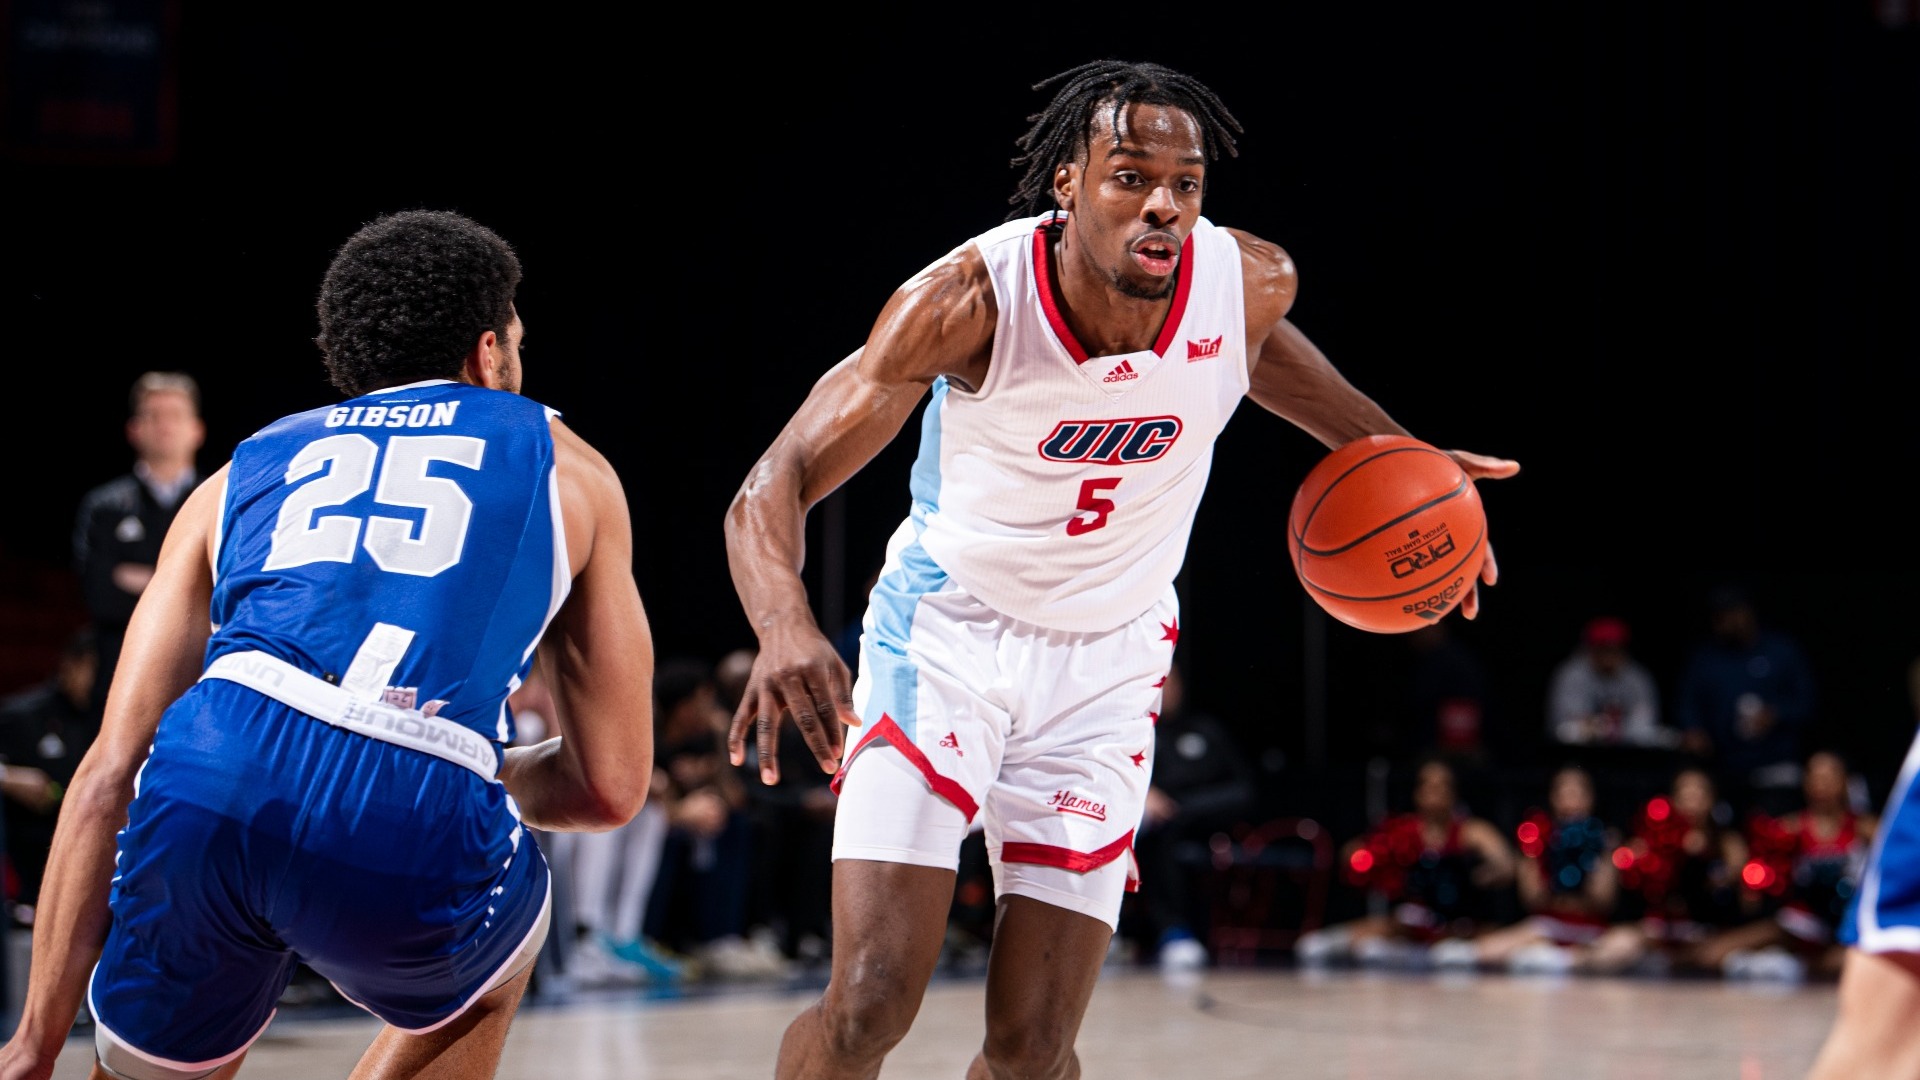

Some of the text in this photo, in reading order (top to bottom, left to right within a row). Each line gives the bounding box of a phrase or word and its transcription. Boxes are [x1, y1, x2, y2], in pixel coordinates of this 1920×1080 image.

[1103, 372, 1139, 383] adidas
[324, 400, 461, 429] GIBSON
[1041, 416, 1181, 463] UIC
[261, 433, 486, 578] 25
[1066, 477, 1123, 536] 5
[1403, 538, 1421, 551] GAME
[1422, 522, 1447, 540] OFFICIAL
[1384, 547, 1403, 558] BALL
[1391, 532, 1456, 579] PRO
[1402, 576, 1464, 614] adidas
[344, 701, 493, 767] ARMOUR
[1047, 790, 1106, 816] Flames
